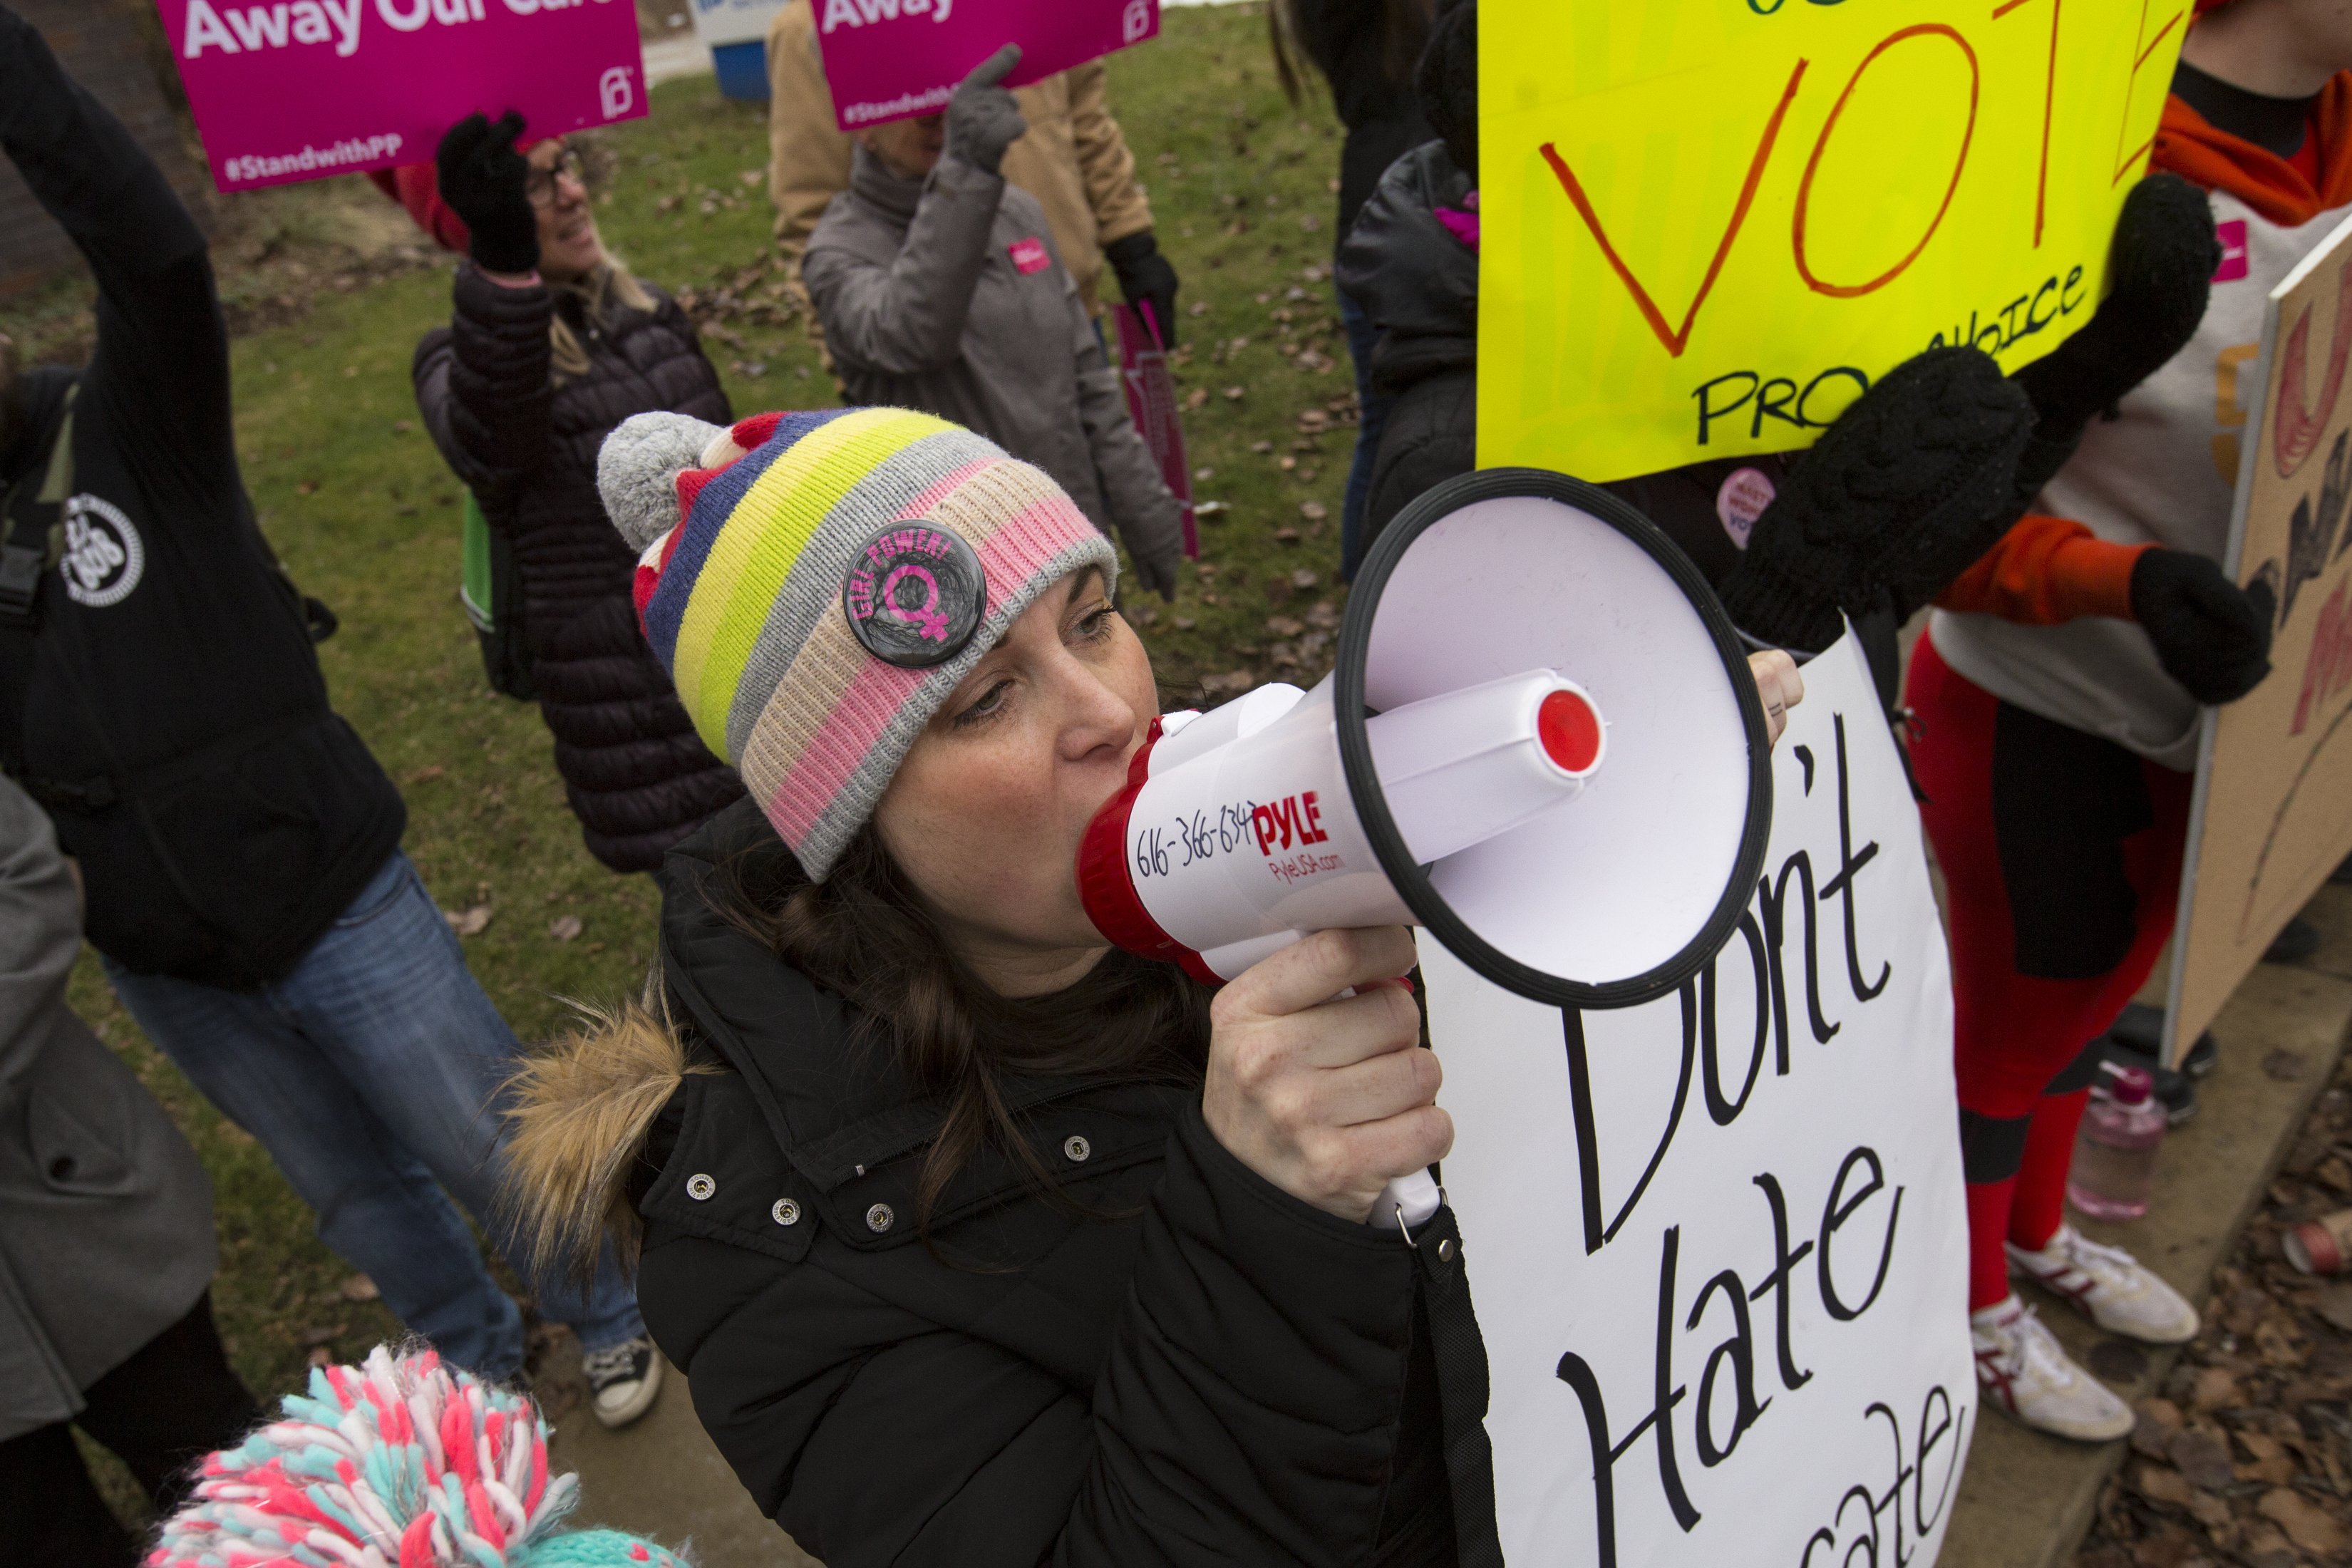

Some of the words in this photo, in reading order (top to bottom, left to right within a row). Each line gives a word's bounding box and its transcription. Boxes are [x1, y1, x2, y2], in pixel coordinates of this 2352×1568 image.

[182, 0, 363, 60] Away
[225, 133, 403, 182] #StandwithPP
[1539, 0, 2184, 356] VOTE
[1691, 366, 1869, 445] PRO
[850, 567, 875, 620] GIRL
[866, 529, 953, 567] POWER!
[1252, 791, 1329, 856] PYLE
[1562, 711, 1891, 1256] Don't
[1556, 1146, 1905, 1568] Hate
